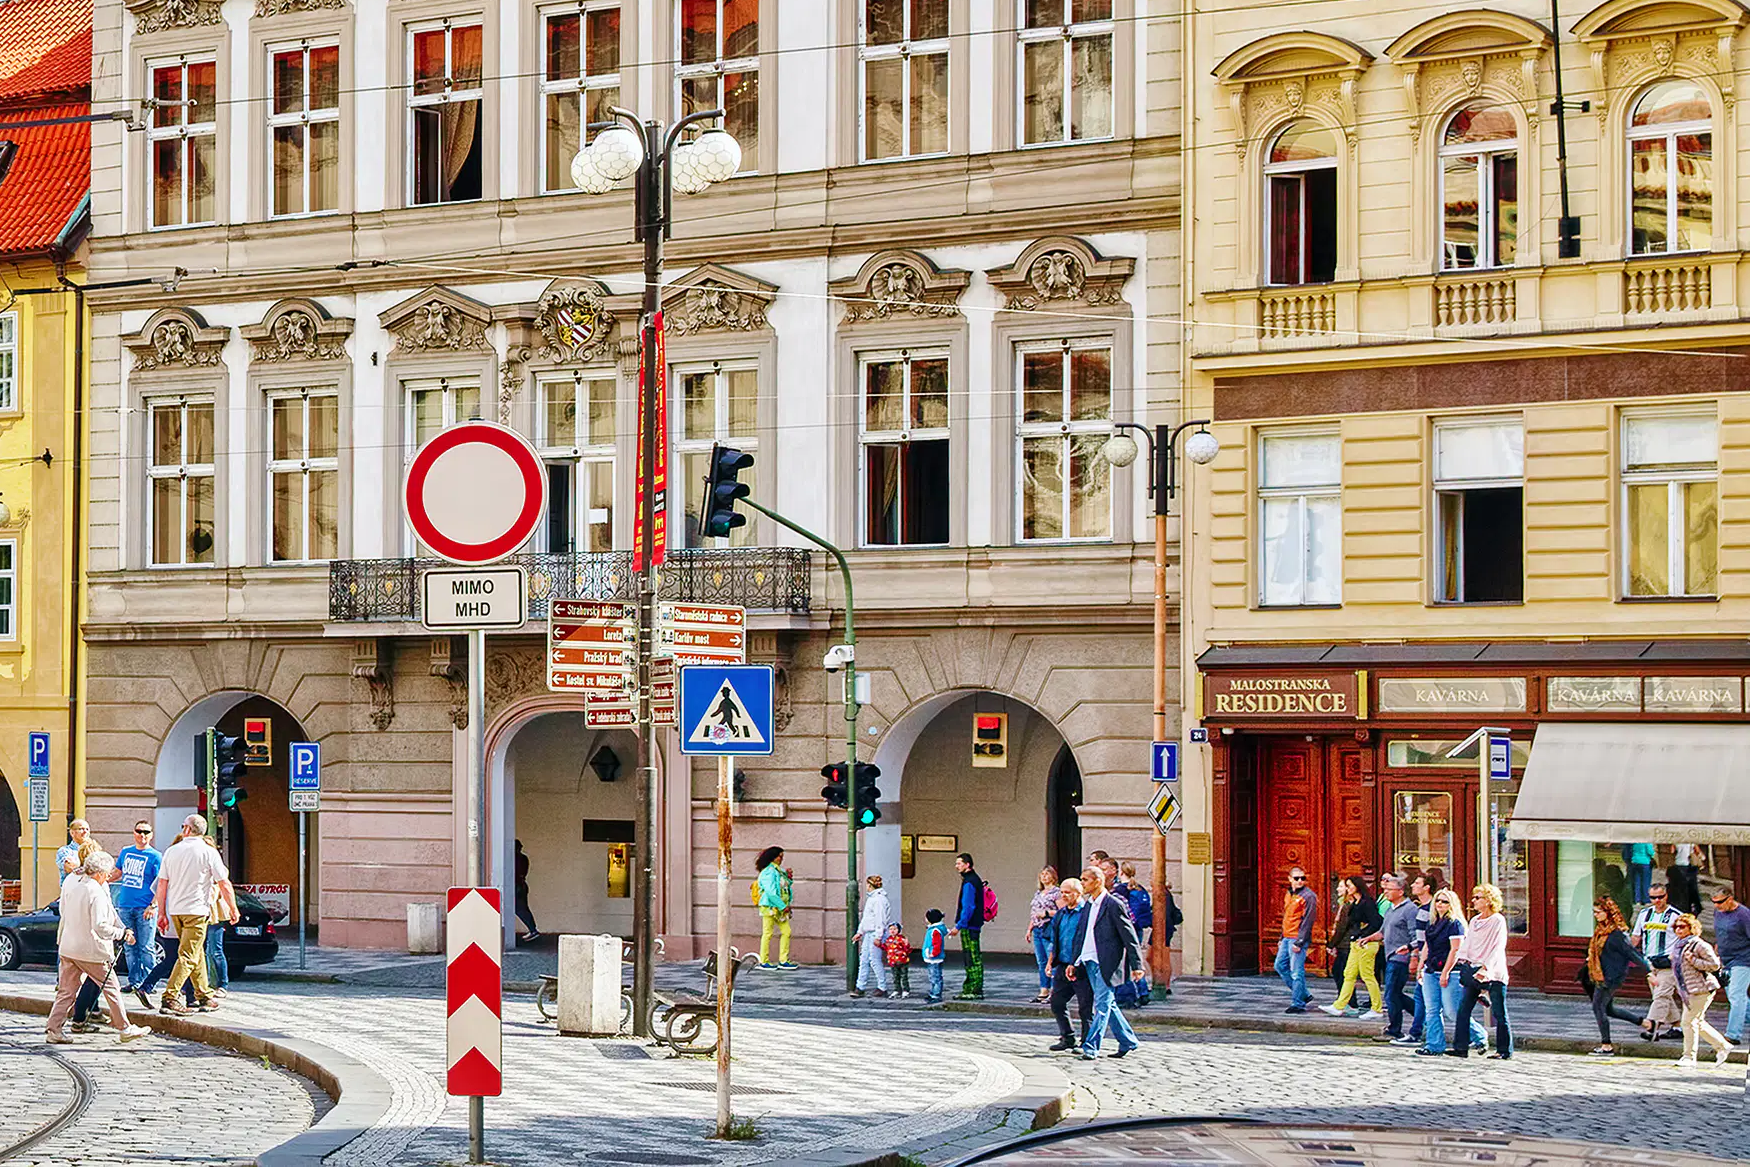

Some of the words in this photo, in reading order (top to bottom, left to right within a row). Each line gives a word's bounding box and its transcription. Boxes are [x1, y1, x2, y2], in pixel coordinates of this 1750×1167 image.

[452, 579, 494, 595] MIMO
[455, 602, 491, 617] MHD
[567, 603, 601, 618] Strahovský
[603, 629, 623, 640] Loreta
[694, 634, 710, 644] most
[583, 651, 607, 665] Pražský
[608, 652, 623, 663] hrad
[566, 674, 586, 685] Kostel
[1230, 679, 1331, 691] MALOSTRANSKA
[1416, 687, 1490, 702] KAVÁRNA
[1557, 687, 1635, 702] KAVÁRNA
[1653, 688, 1733, 702] KAVÁRNA
[1215, 693, 1347, 713] RESIDENCE
[1193, 732, 1203, 740] 24
[33, 738, 46, 763] P
[973, 743, 1004, 756] KB
[297, 749, 314, 775] P
[259, 885, 288, 894] GYROS
